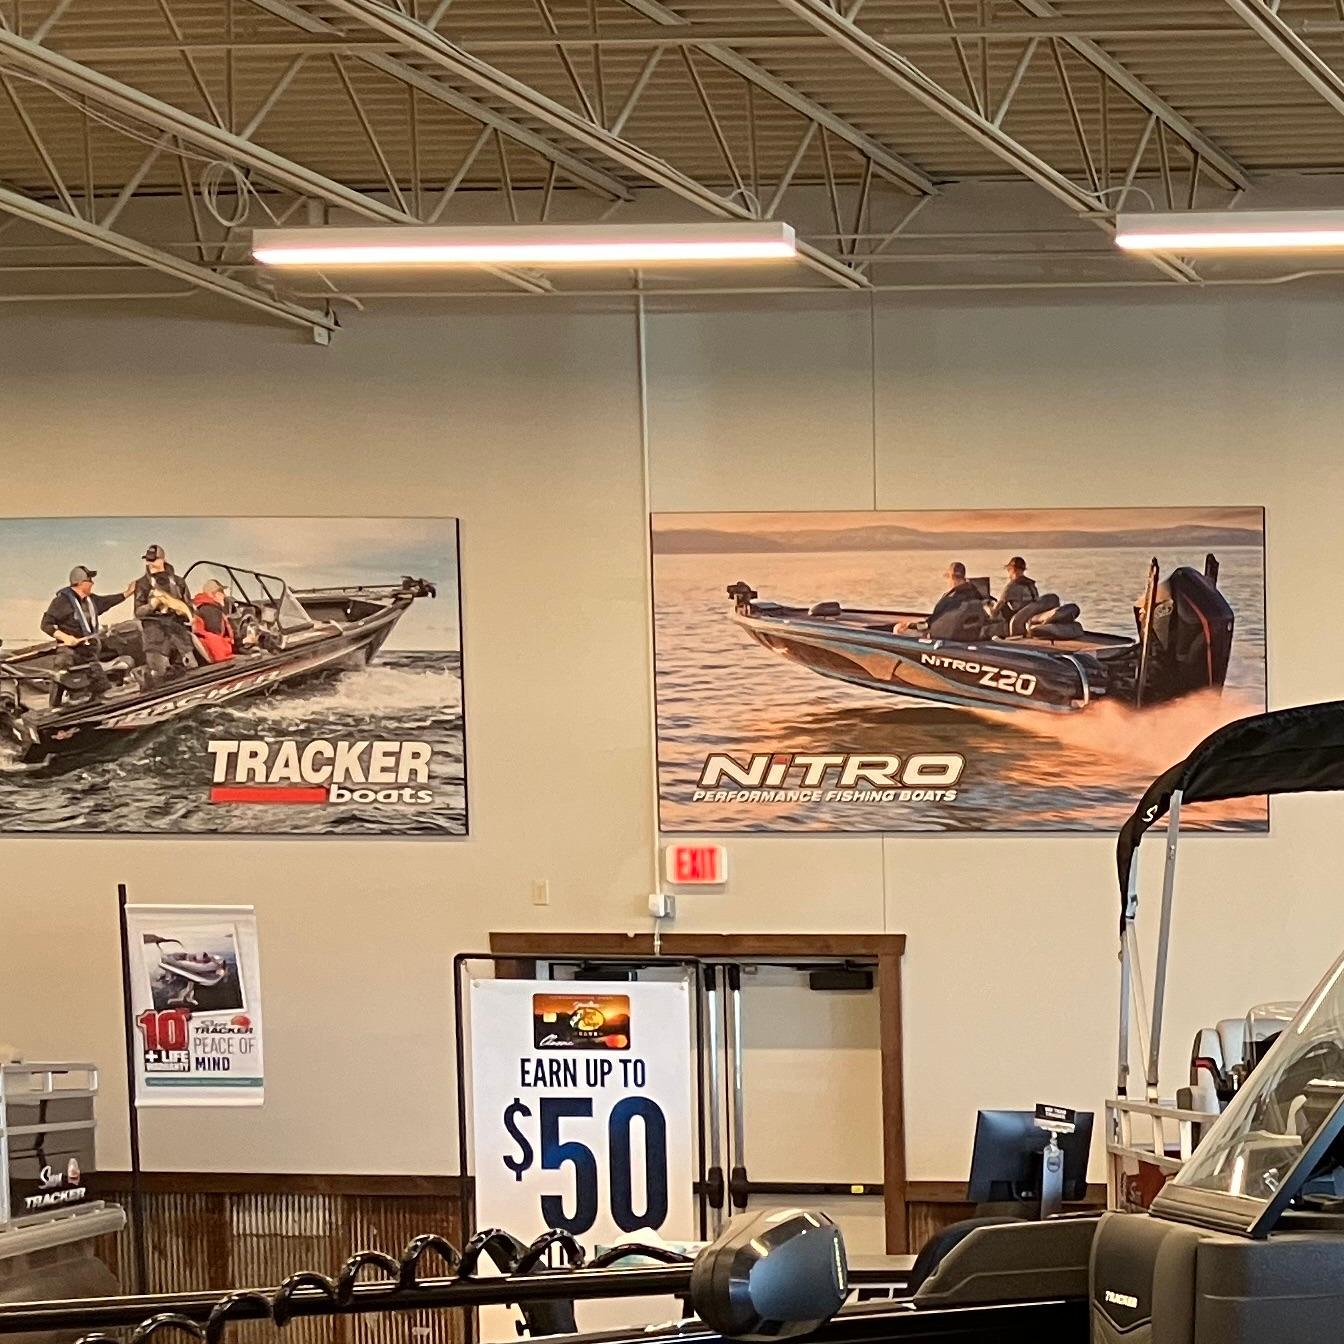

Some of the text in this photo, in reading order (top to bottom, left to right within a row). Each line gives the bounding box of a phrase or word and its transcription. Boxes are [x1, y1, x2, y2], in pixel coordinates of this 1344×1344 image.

[979, 664, 1037, 696] Z20
[208, 740, 433, 784] TRACKER
[328, 784, 433, 804] boats
[692, 789, 958, 803] PERFORMANCE FISHING BOATS
[676, 848, 716, 882] EXIT
[161, 1050, 189, 1063] LIFE
[193, 1036, 257, 1055] PEACE OF
[195, 1056, 231, 1073] MIND
[520, 1057, 646, 1088] EARN UP TO
[502, 1095, 669, 1236] $50
[24, 1187, 86, 1209] TRACKER
